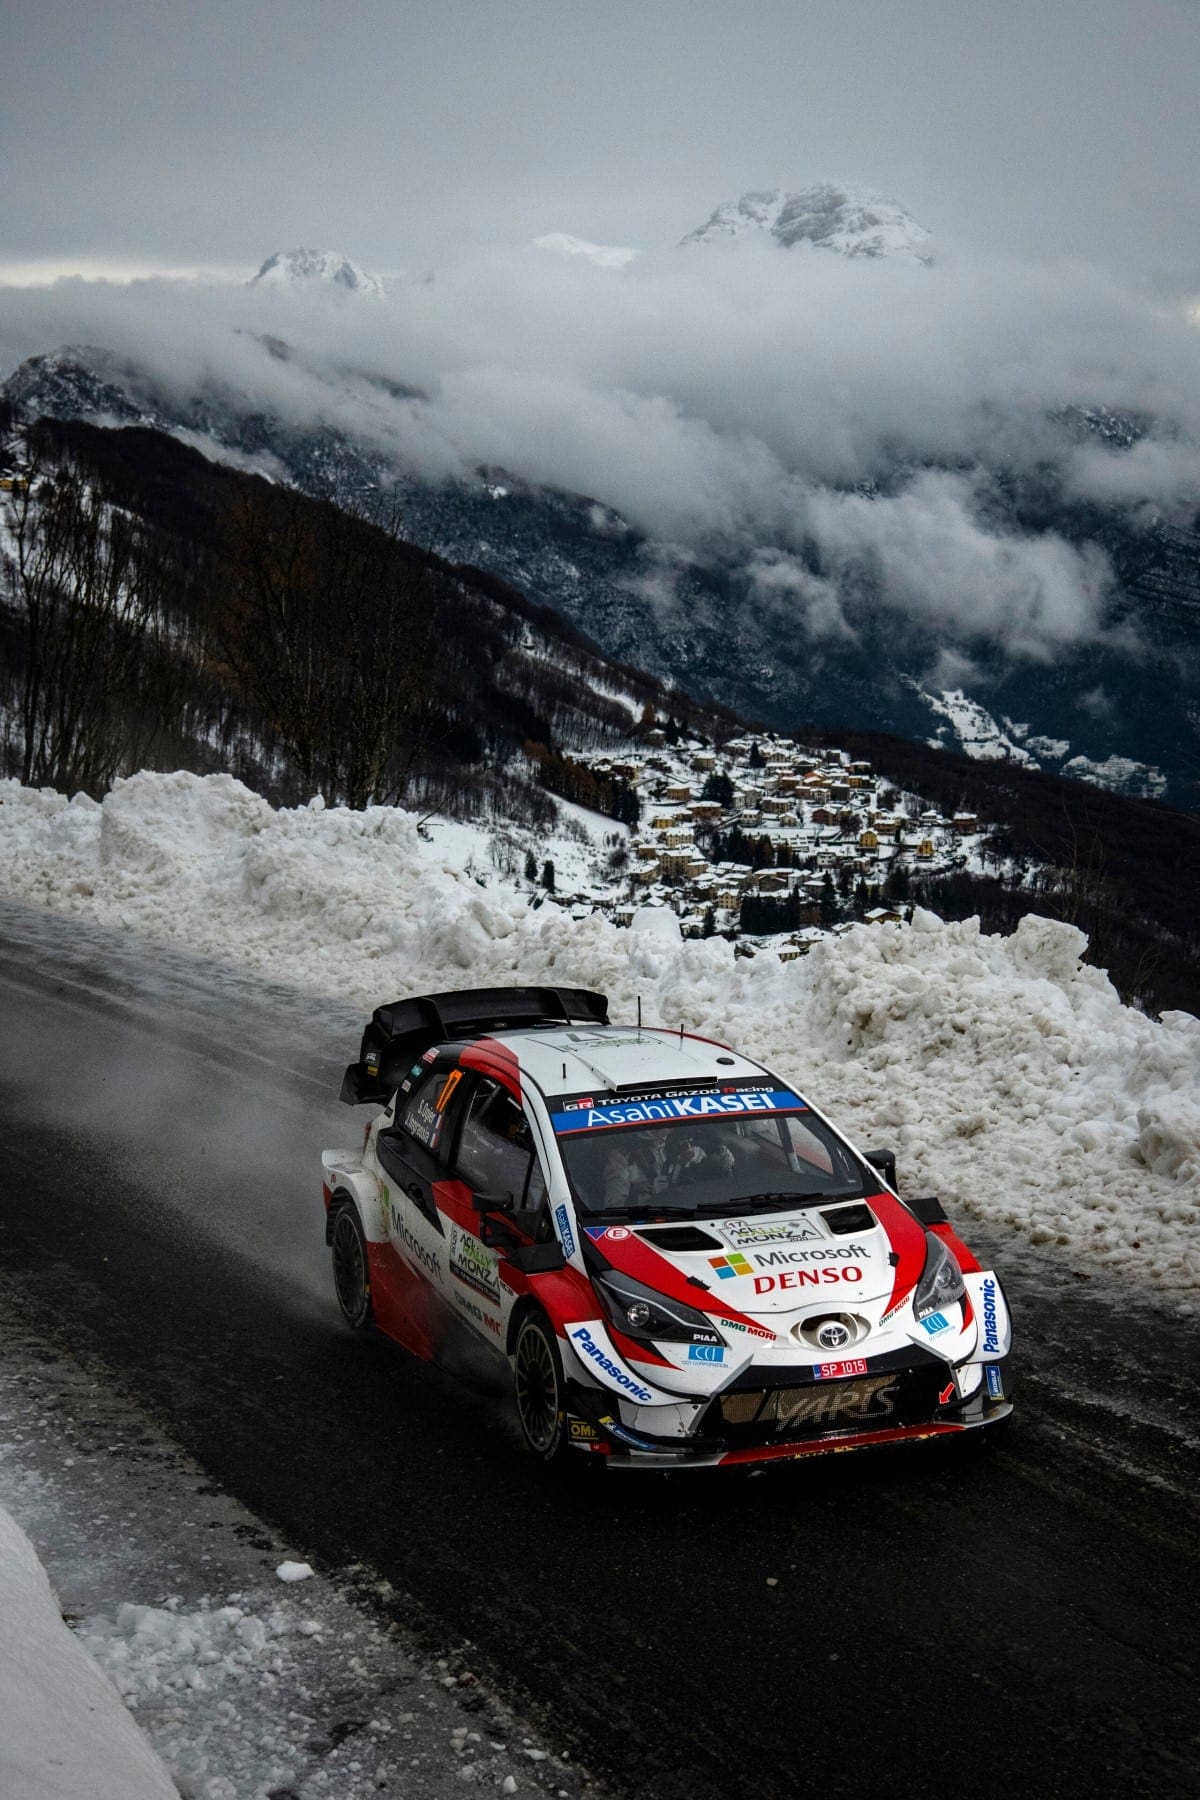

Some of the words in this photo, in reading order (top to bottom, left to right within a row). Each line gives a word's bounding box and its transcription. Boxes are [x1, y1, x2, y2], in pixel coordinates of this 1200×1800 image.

[565, 1101, 594, 1111] GR
[598, 1093, 661, 1106] TOYOTA
[665, 1088, 720, 1098] GAZOO
[722, 1086, 774, 1094] Racing
[612, 1229, 623, 1238] E
[728, 1221, 742, 1229] 17
[391, 1204, 444, 1285] Microsoft
[736, 1229, 816, 1245] MONZA
[753, 1244, 872, 1267] Microsoft
[457, 1252, 501, 1292] MONZA
[753, 1265, 863, 1295] DENSO
[980, 1278, 1000, 1354] Panasonic
[693, 1333, 718, 1343] PIAA
[720, 1318, 746, 1332] DMG
[747, 1326, 777, 1341] MORI
[571, 1327, 652, 1401] Panasonic
[821, 1364, 837, 1377] SP
[841, 1360, 866, 1374] 1015
